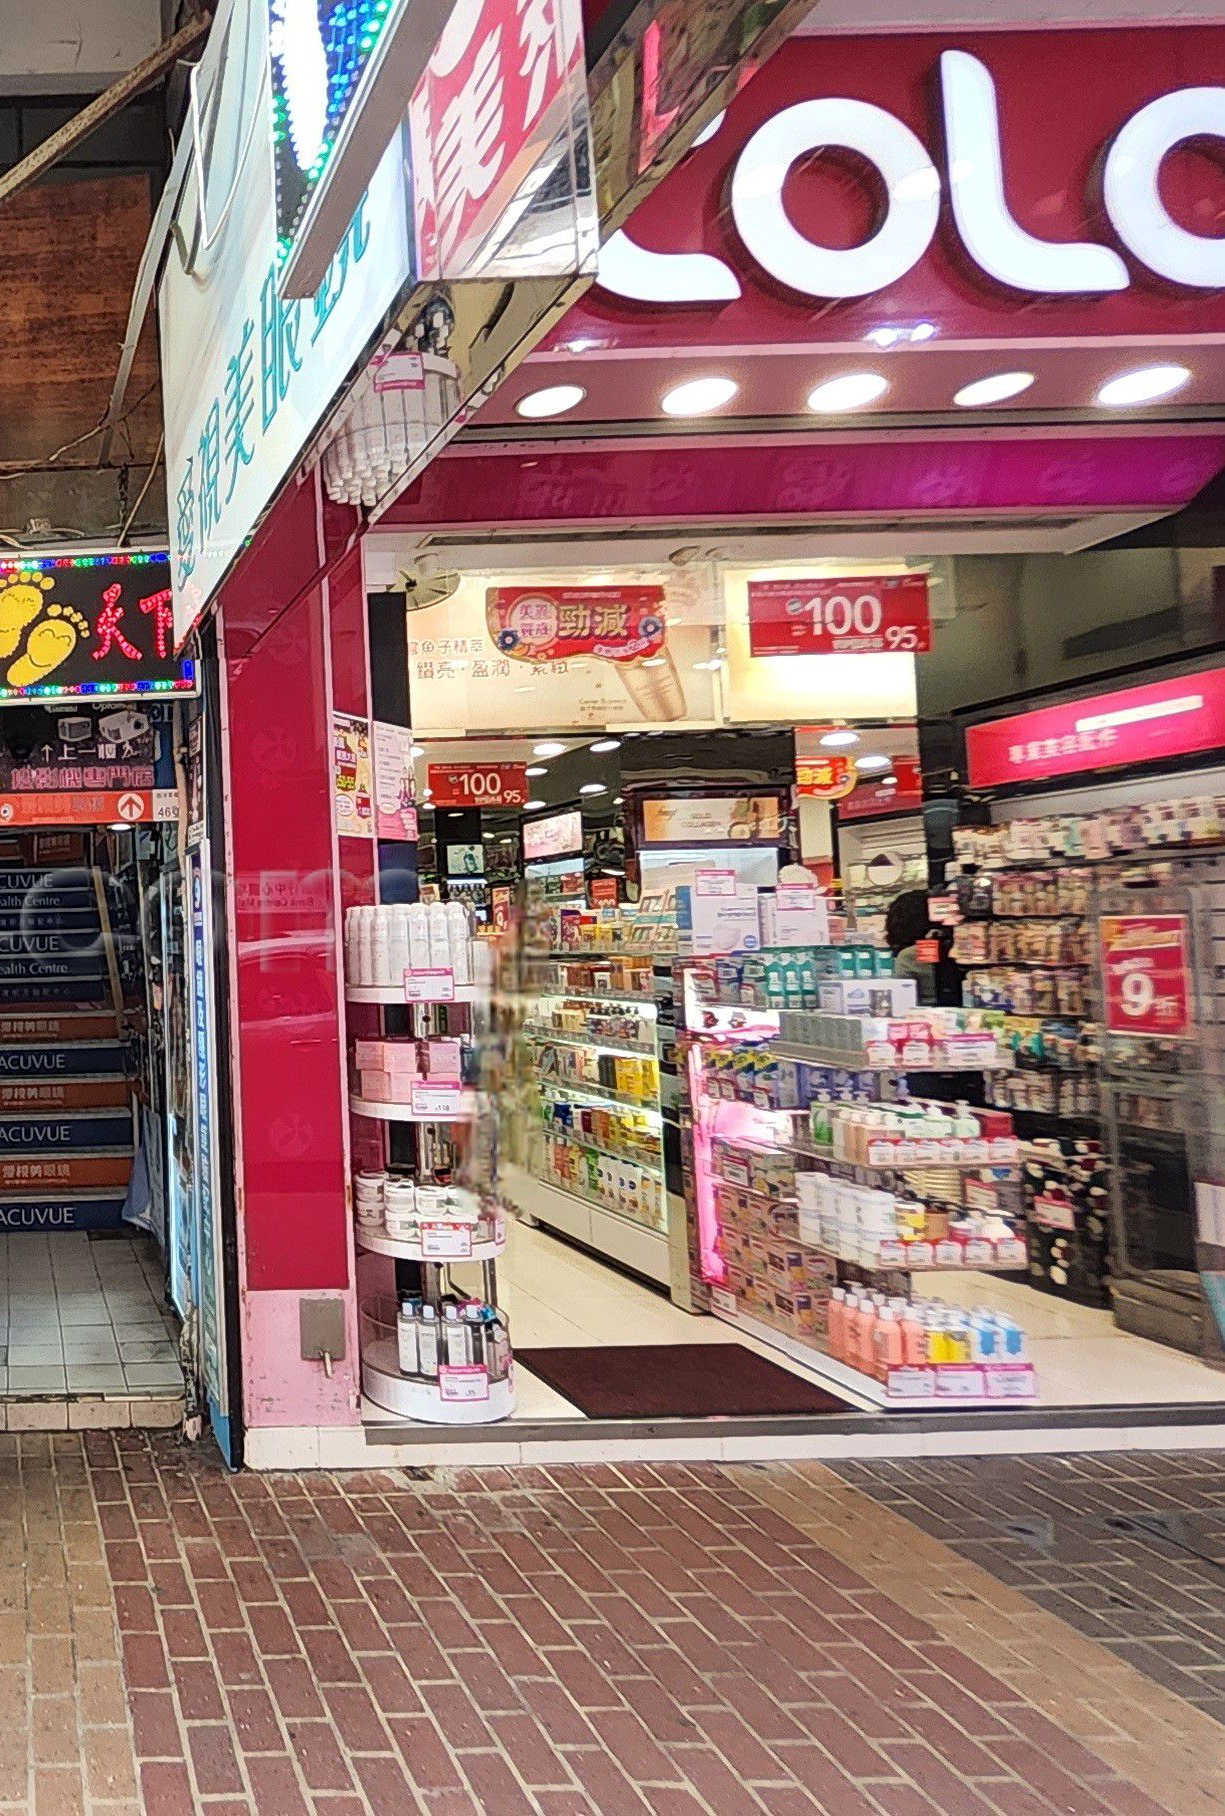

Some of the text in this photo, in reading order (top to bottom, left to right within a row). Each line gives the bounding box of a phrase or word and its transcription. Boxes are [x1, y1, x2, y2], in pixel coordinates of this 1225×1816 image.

[558, 604, 628, 638] 勁減
[804, 594, 882, 636] 100
[458, 772, 502, 796] 100
[24, 896, 61, 907] Centre
[29, 963, 69, 974] Centre
